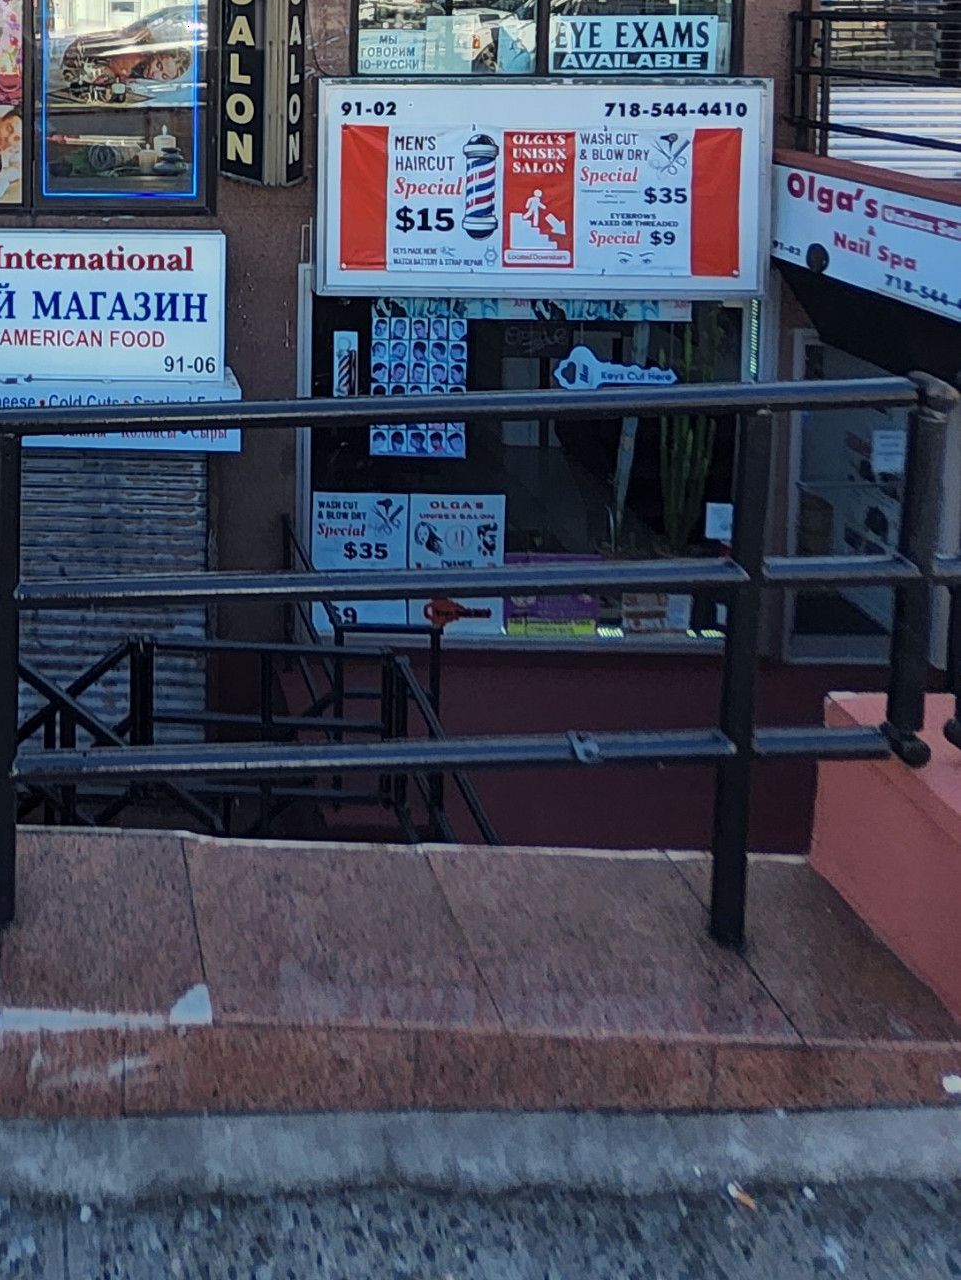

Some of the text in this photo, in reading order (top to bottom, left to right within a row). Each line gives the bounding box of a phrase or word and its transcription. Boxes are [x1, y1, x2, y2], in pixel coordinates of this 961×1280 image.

[379, 35, 398, 45] МЫ
[555, 20, 710, 49] EYE EXAMS
[361, 46, 415, 57] ГОВОРИМ
[560, 51, 702, 68] AVAILABLE
[341, 102, 748, 118] 91-02 718-544-4410
[395, 136, 436, 151] MEN'S
[512, 134, 566, 145] OLGA'S
[580, 133, 637, 145] WASH CUT
[512, 148, 567, 160] UNISEX
[579, 149, 650, 161] & BLOW DRY
[395, 156, 455, 171] HAIRCUT
[512, 162, 565, 173] SALON
[580, 166, 638, 186] Special
[394, 177, 463, 199] Special
[644, 186, 688, 205] $35
[787, 172, 878, 219] Olga's
[395, 205, 455, 233] $15
[589, 230, 676, 247] Special $9
[833, 231, 917, 271] Nail Spa
[32, 290, 208, 323] МАГАЗИН
[0, 329, 102, 347] AMERICAN
[109, 330, 165, 348] FOOD
[164, 356, 216, 374] 91-06
[601, 371, 624, 381] Keys
[318, 501, 358, 510] WASH CUT
[317, 523, 366, 538] Special
[343, 541, 388, 560] $35
